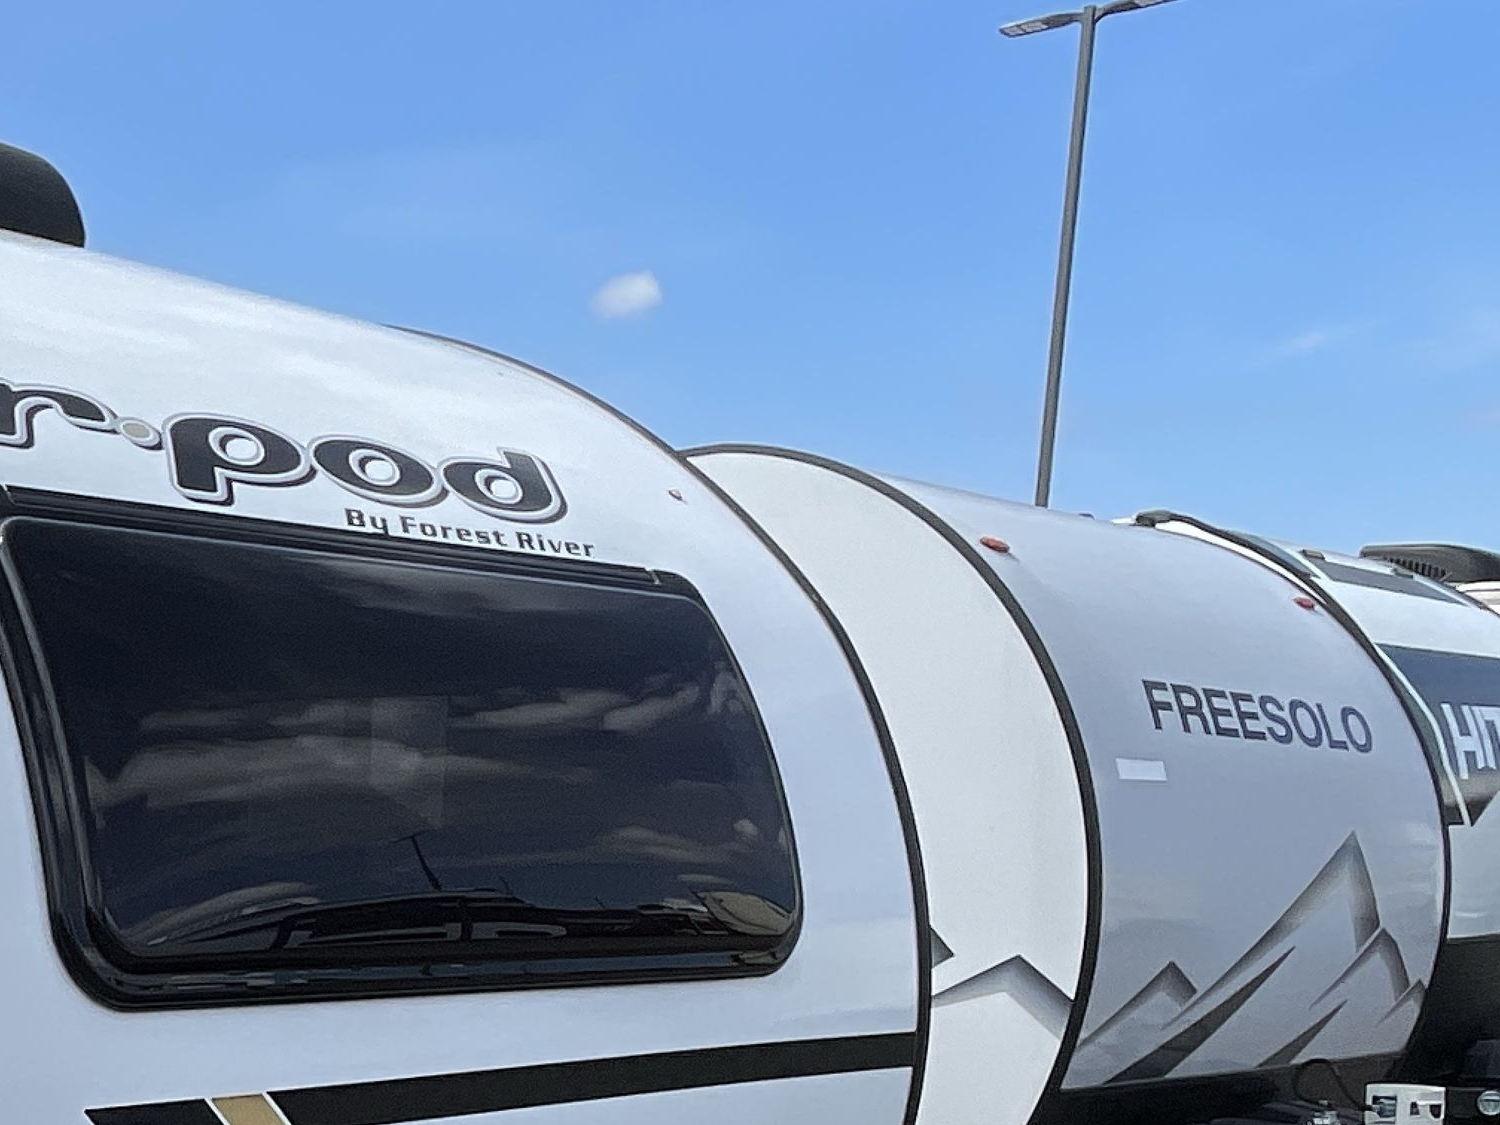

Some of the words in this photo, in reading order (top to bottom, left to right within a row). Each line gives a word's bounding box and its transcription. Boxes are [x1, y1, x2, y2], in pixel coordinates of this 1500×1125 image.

[344, 508, 390, 535] By
[399, 514, 508, 547] Forest
[515, 531, 595, 557] River
[1141, 679, 1373, 754] FREESOLO
[1440, 702, 1500, 780] HI
